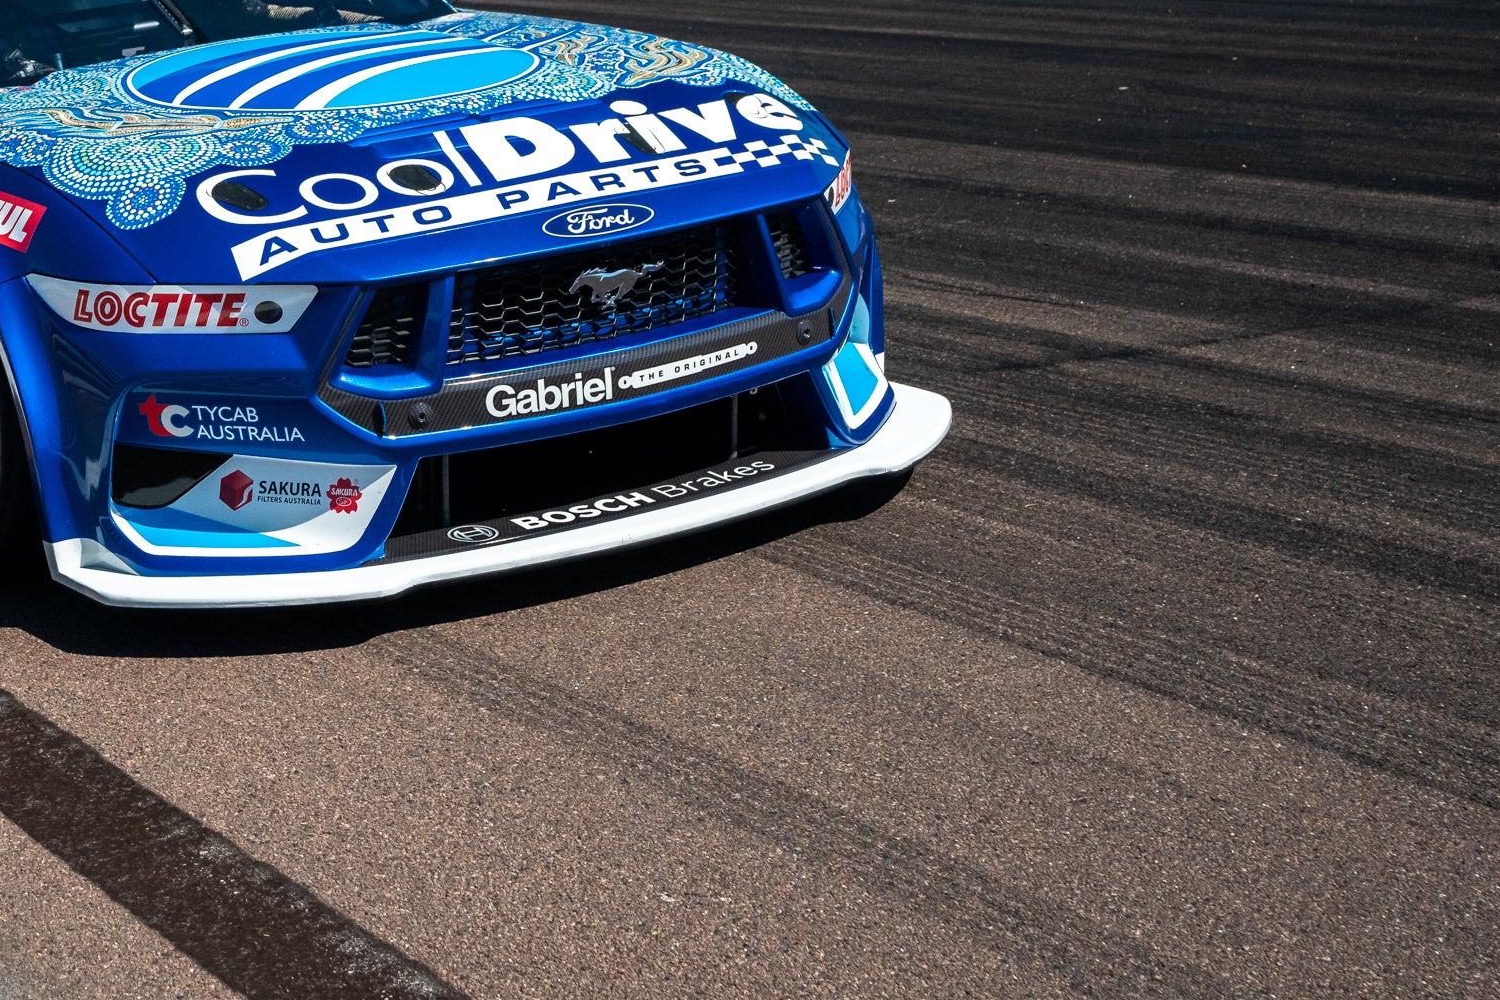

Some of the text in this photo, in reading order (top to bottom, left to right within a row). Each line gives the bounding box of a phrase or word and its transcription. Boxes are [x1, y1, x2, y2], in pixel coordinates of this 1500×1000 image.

[196, 92, 803, 225] CoolDrive
[258, 158, 703, 266] AUTO PARTS
[563, 206, 635, 233] Ford
[74, 289, 246, 328] LOCTITE
[640, 350, 739, 382] THE ORIGINAL
[485, 368, 613, 419] Gabriel
[192, 405, 259, 423] TYCAB
[197, 424, 305, 442] AUSTRALIA
[257, 495, 322, 506] FILTERS AUSTRALIA
[258, 479, 322, 498] SAKURA
[331, 488, 358, 497] SAKURA
[510, 457, 775, 531] BOSCH Brakes
